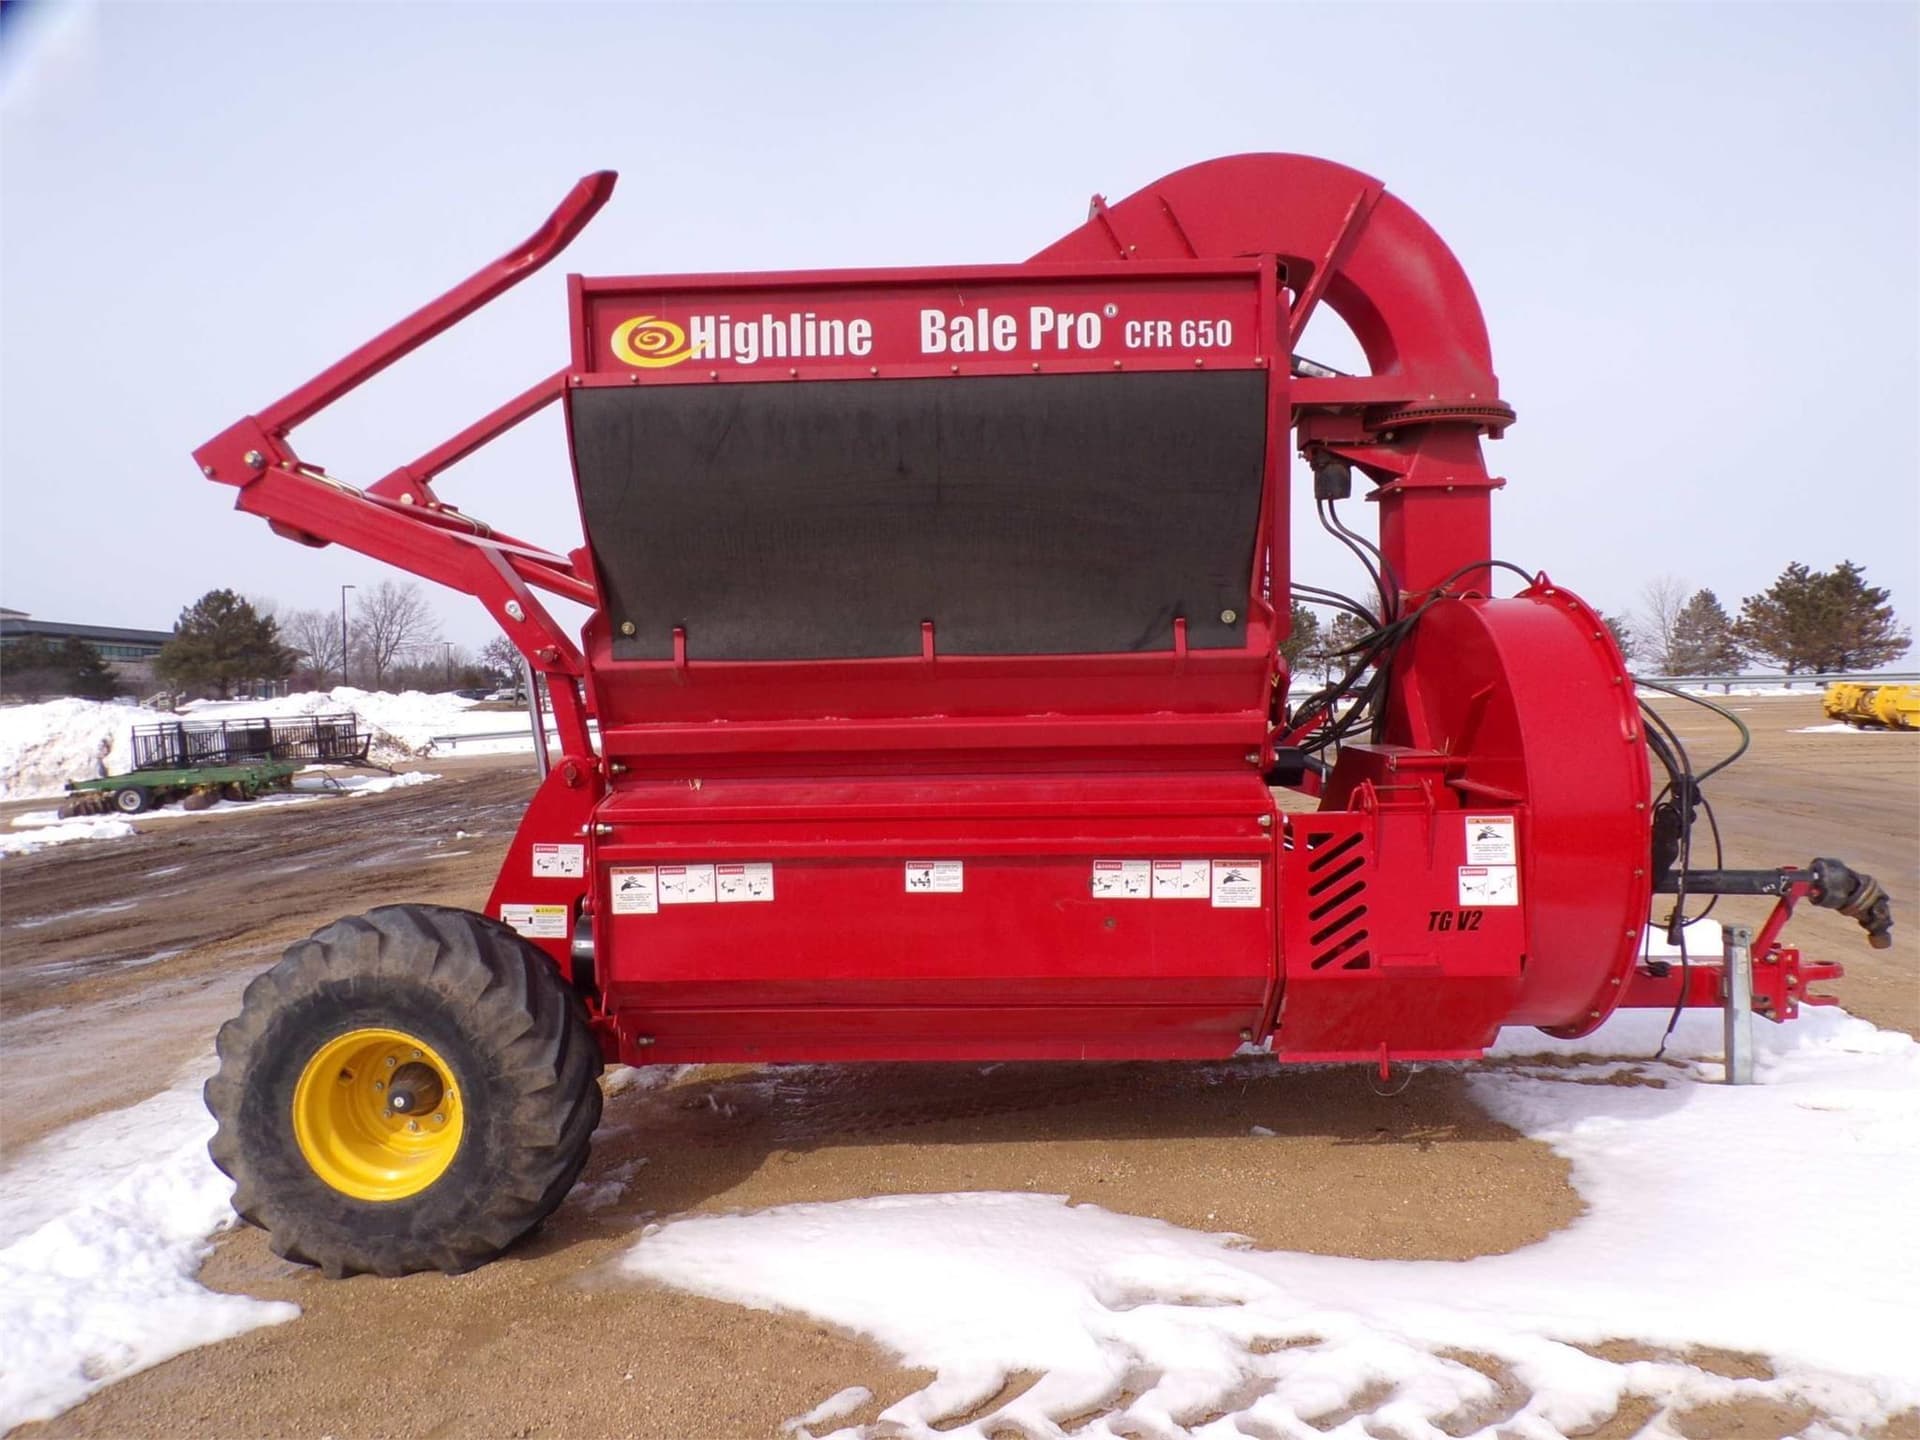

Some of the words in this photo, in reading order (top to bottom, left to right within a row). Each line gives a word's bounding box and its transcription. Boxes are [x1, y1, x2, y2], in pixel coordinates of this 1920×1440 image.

[690, 313, 872, 364] Highline
[920, 308, 1017, 353] Bale
[1125, 320, 1173, 349] CFR
[1180, 319, 1233, 348] 650
[1428, 910, 1454, 932] TG
[1456, 910, 1483, 932] V2
